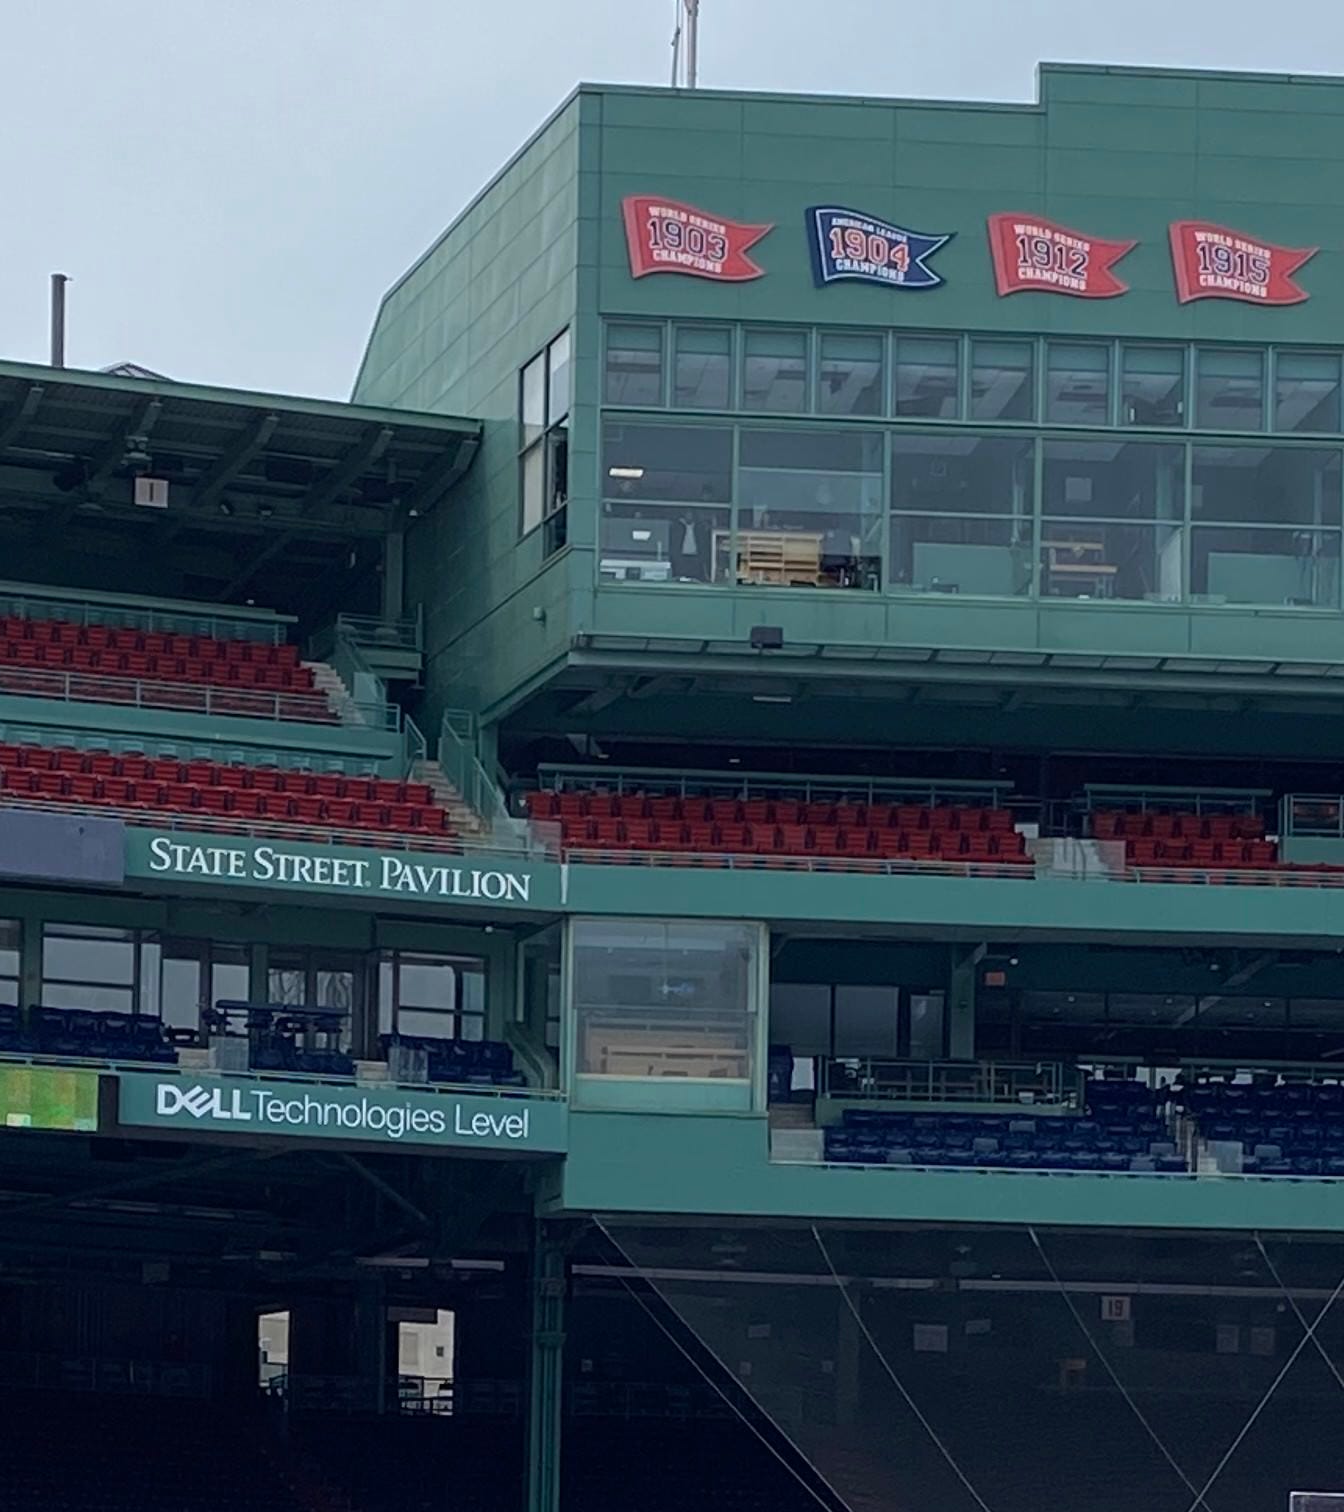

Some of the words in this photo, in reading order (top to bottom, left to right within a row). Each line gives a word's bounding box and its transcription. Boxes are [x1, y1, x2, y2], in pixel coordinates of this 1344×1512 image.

[647, 216, 727, 261] 1903
[830, 226, 909, 272] 1904
[1015, 233, 1088, 279] 1912
[652, 249, 721, 273] CHAMPIONS
[836, 259, 904, 282] CHAMPIONS
[1018, 267, 1086, 291] CHAMPIONS
[1196, 242, 1270, 286] 1915
[1199, 275, 1267, 297] CHAMPIONS
[149, 482, 155, 501] 1
[150, 837, 246, 878] STATE
[253, 846, 371, 887] STREET
[380, 857, 530, 901] PAVILION
[157, 1084, 251, 1120] DELL
[250, 1090, 446, 1139] Technologies
[455, 1104, 528, 1139] Level
